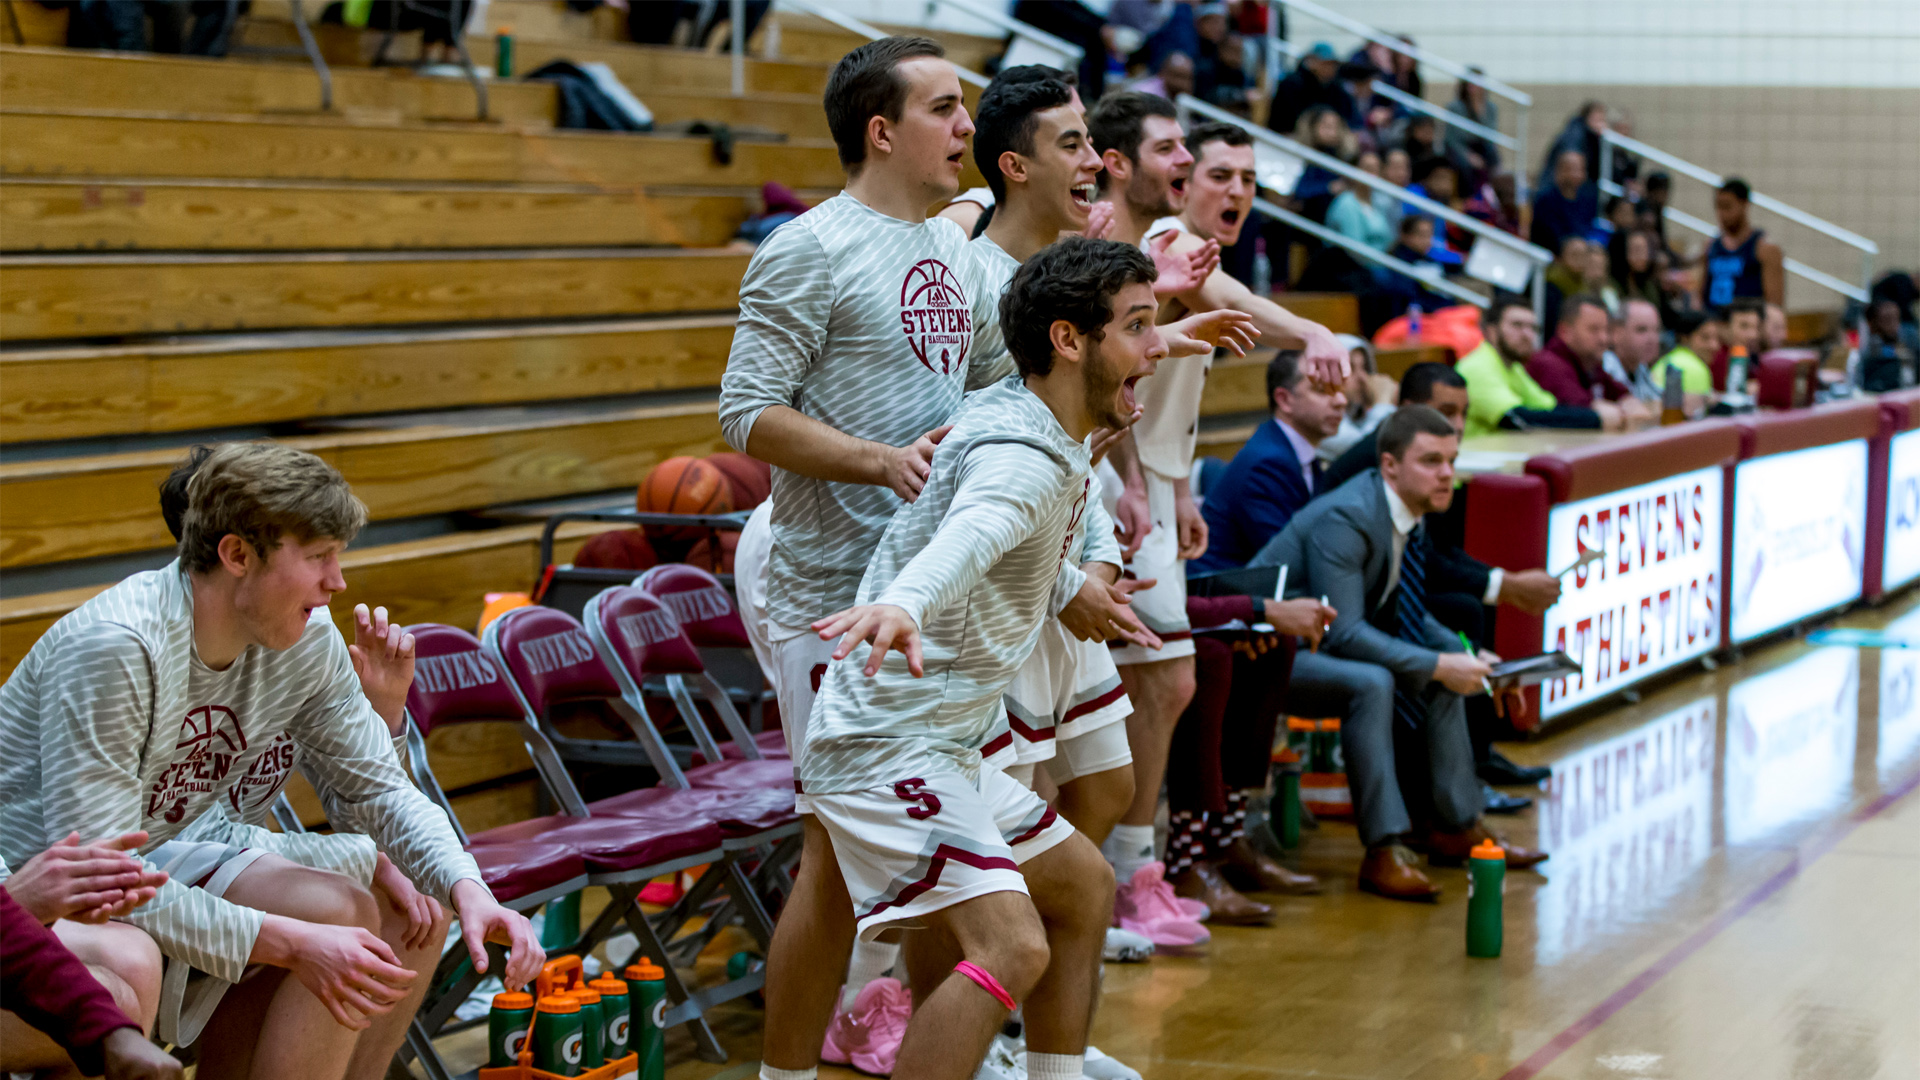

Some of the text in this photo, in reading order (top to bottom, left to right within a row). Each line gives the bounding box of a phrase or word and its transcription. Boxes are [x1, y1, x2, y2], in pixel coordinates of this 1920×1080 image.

[900, 308, 972, 335] STEVENS
[928, 335, 960, 344] BASKETBALL
[1576, 485, 1702, 589] STEVENS
[518, 627, 594, 675] STEVENS
[1550, 573, 1713, 702] ATHLETICS
[164, 796, 188, 824] S
[894, 777, 942, 820] S
